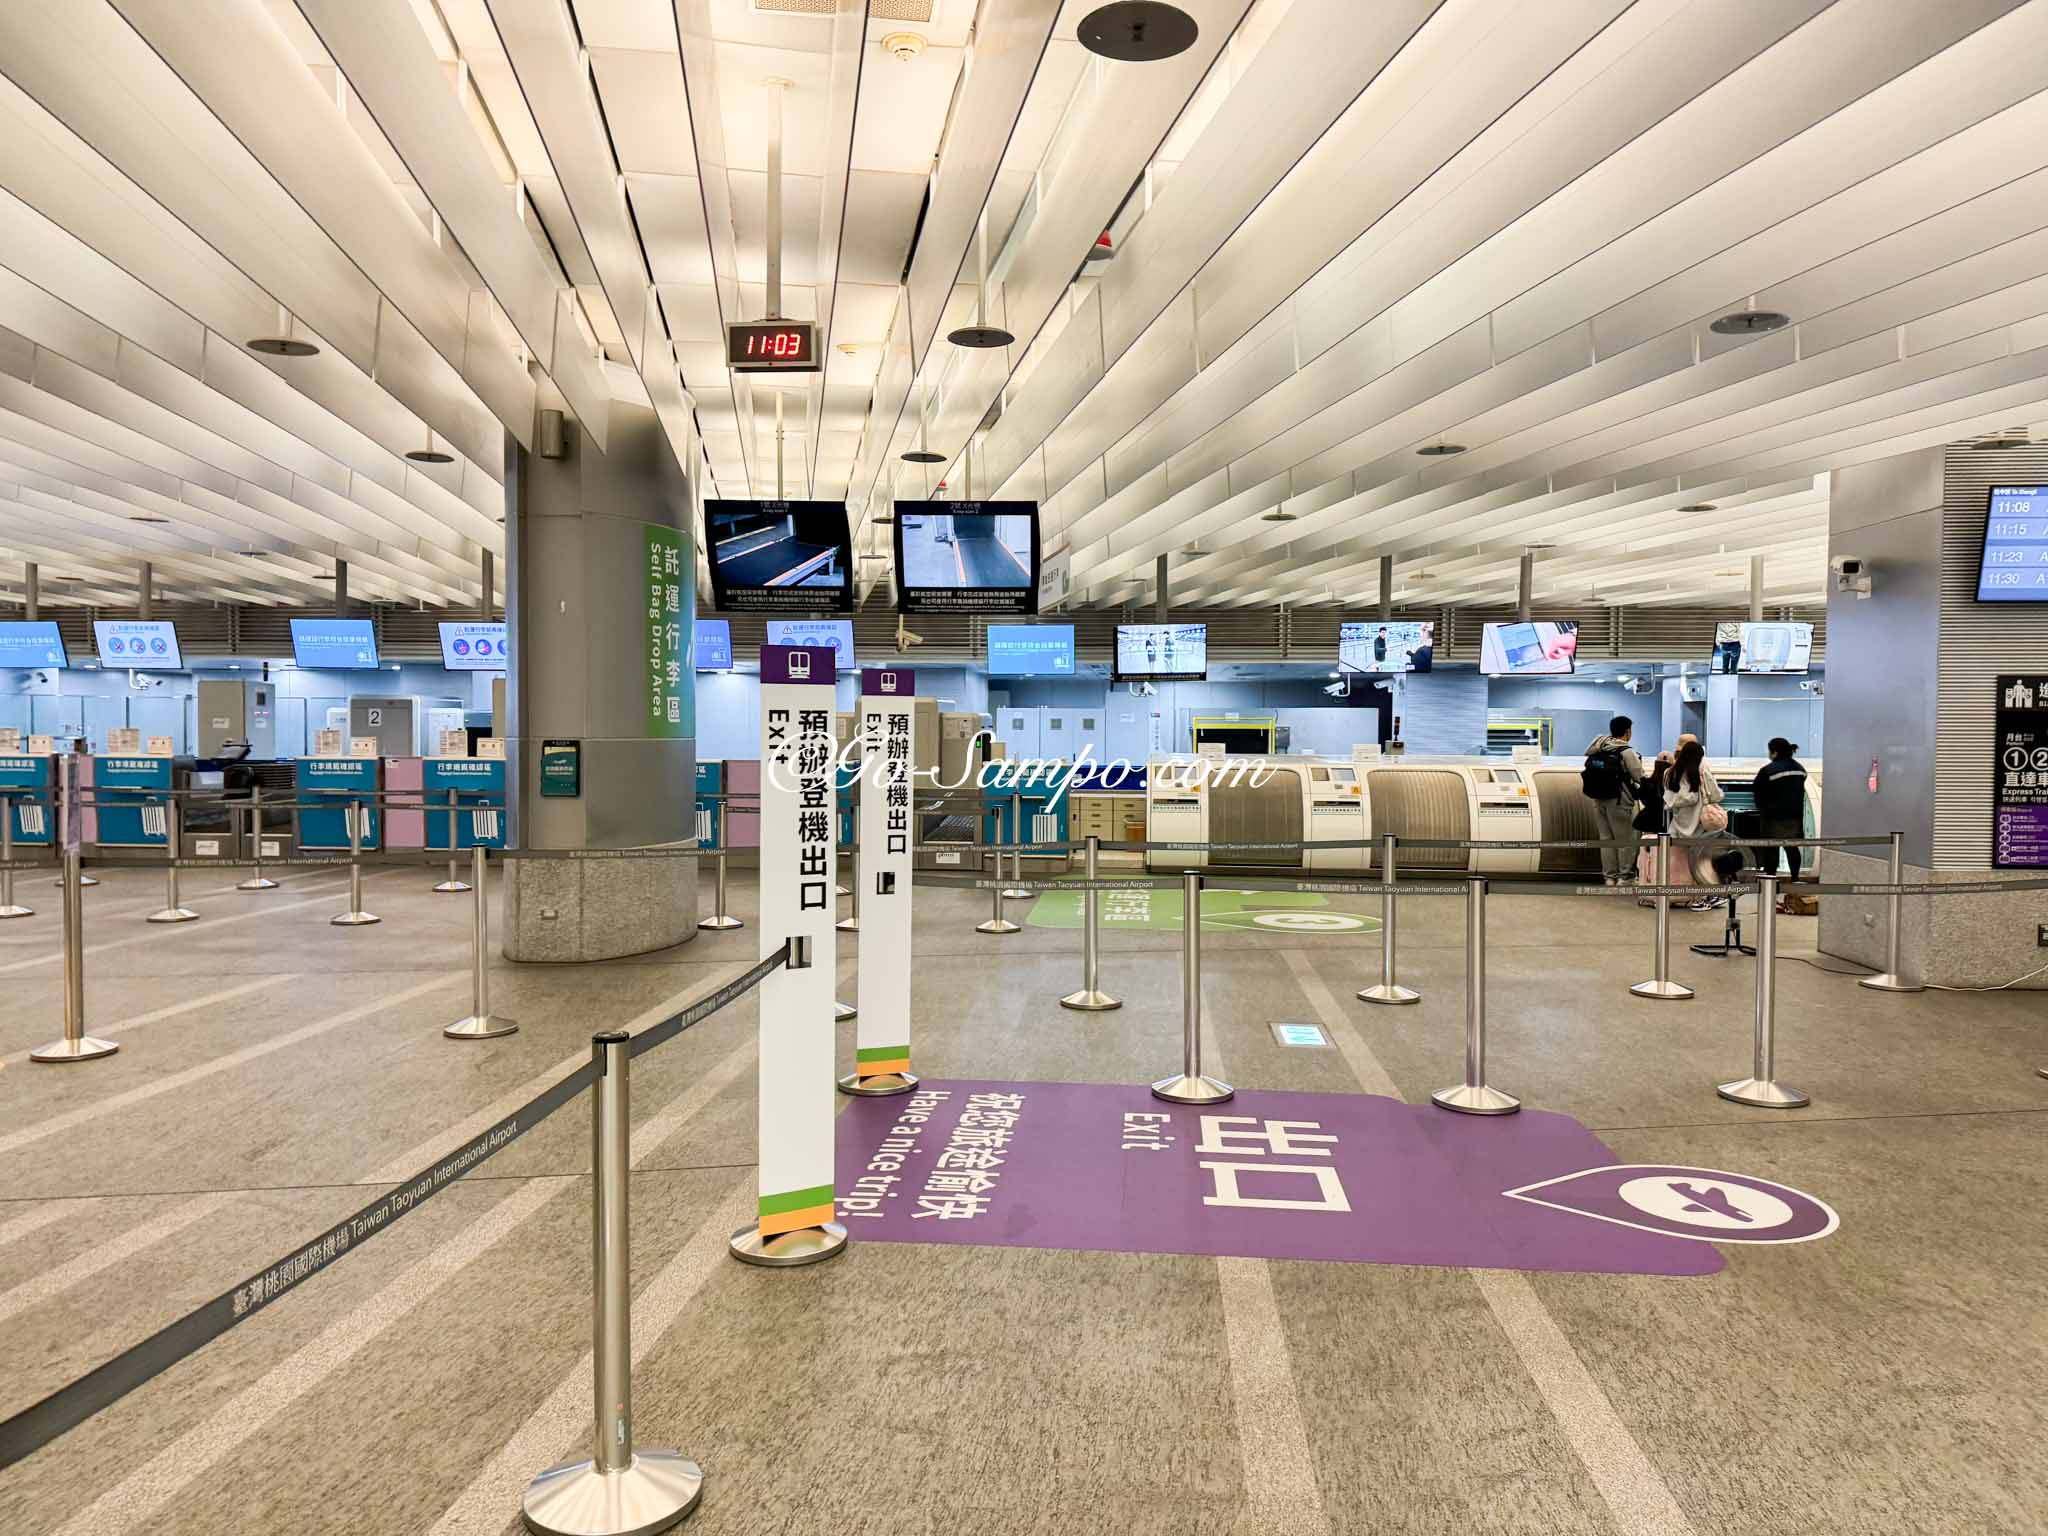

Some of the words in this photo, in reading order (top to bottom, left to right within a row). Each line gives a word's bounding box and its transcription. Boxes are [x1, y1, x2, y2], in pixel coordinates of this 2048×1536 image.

[747, 334, 800, 355] 11:03
[1998, 501, 2031, 513] 11:08
[651, 543, 662, 580] Self
[1991, 551, 2023, 562] 11:23
[1988, 573, 2019, 584] 11:30
[650, 584, 662, 619] Bag
[650, 624, 662, 670] Drop
[665, 546, 681, 723] 託運行李區
[652, 675, 663, 717] Area
[370, 710, 380, 725] 2
[866, 713, 882, 753] Exit
[768, 709, 791, 764] Exit
[887, 713, 909, 855] 預辦登機出口
[2002, 787, 2034, 797] Express
[2003, 771, 2048, 787] 直達車
[798, 710, 829, 911] 預辦登機出口
[1033, 881, 1057, 889] Taiwan
[1057, 880, 1086, 890] Taoyuan
[1086, 880, 1129, 889] International
[1129, 880, 1153, 889] Airport
[1359, 884, 1383, 892] Taiwan
[1383, 884, 1415, 894] Taoyuan
[1415, 884, 1460, 893] International
[1635, 886, 1657, 894] Taiwan
[1657, 886, 1684, 896] Taoyuan
[1685, 886, 1727, 894] International
[1728, 885, 1751, 895] Airport
[899, 1090, 952, 1124] Have
[890, 1125, 922, 1135] a
[1121, 1111, 1176, 1151] Exit
[866, 1138, 922, 1171] nice
[911, 1092, 1026, 1220] 祝您旅途愉快
[1194, 1115, 1352, 1212] 出口
[350, 1206, 390, 1239] Taiwan
[390, 1178, 433, 1213] Taoyuan
[434, 1140, 489, 1185] International
[489, 1120, 518, 1148] Airport
[834, 1174, 901, 1217] trip!
